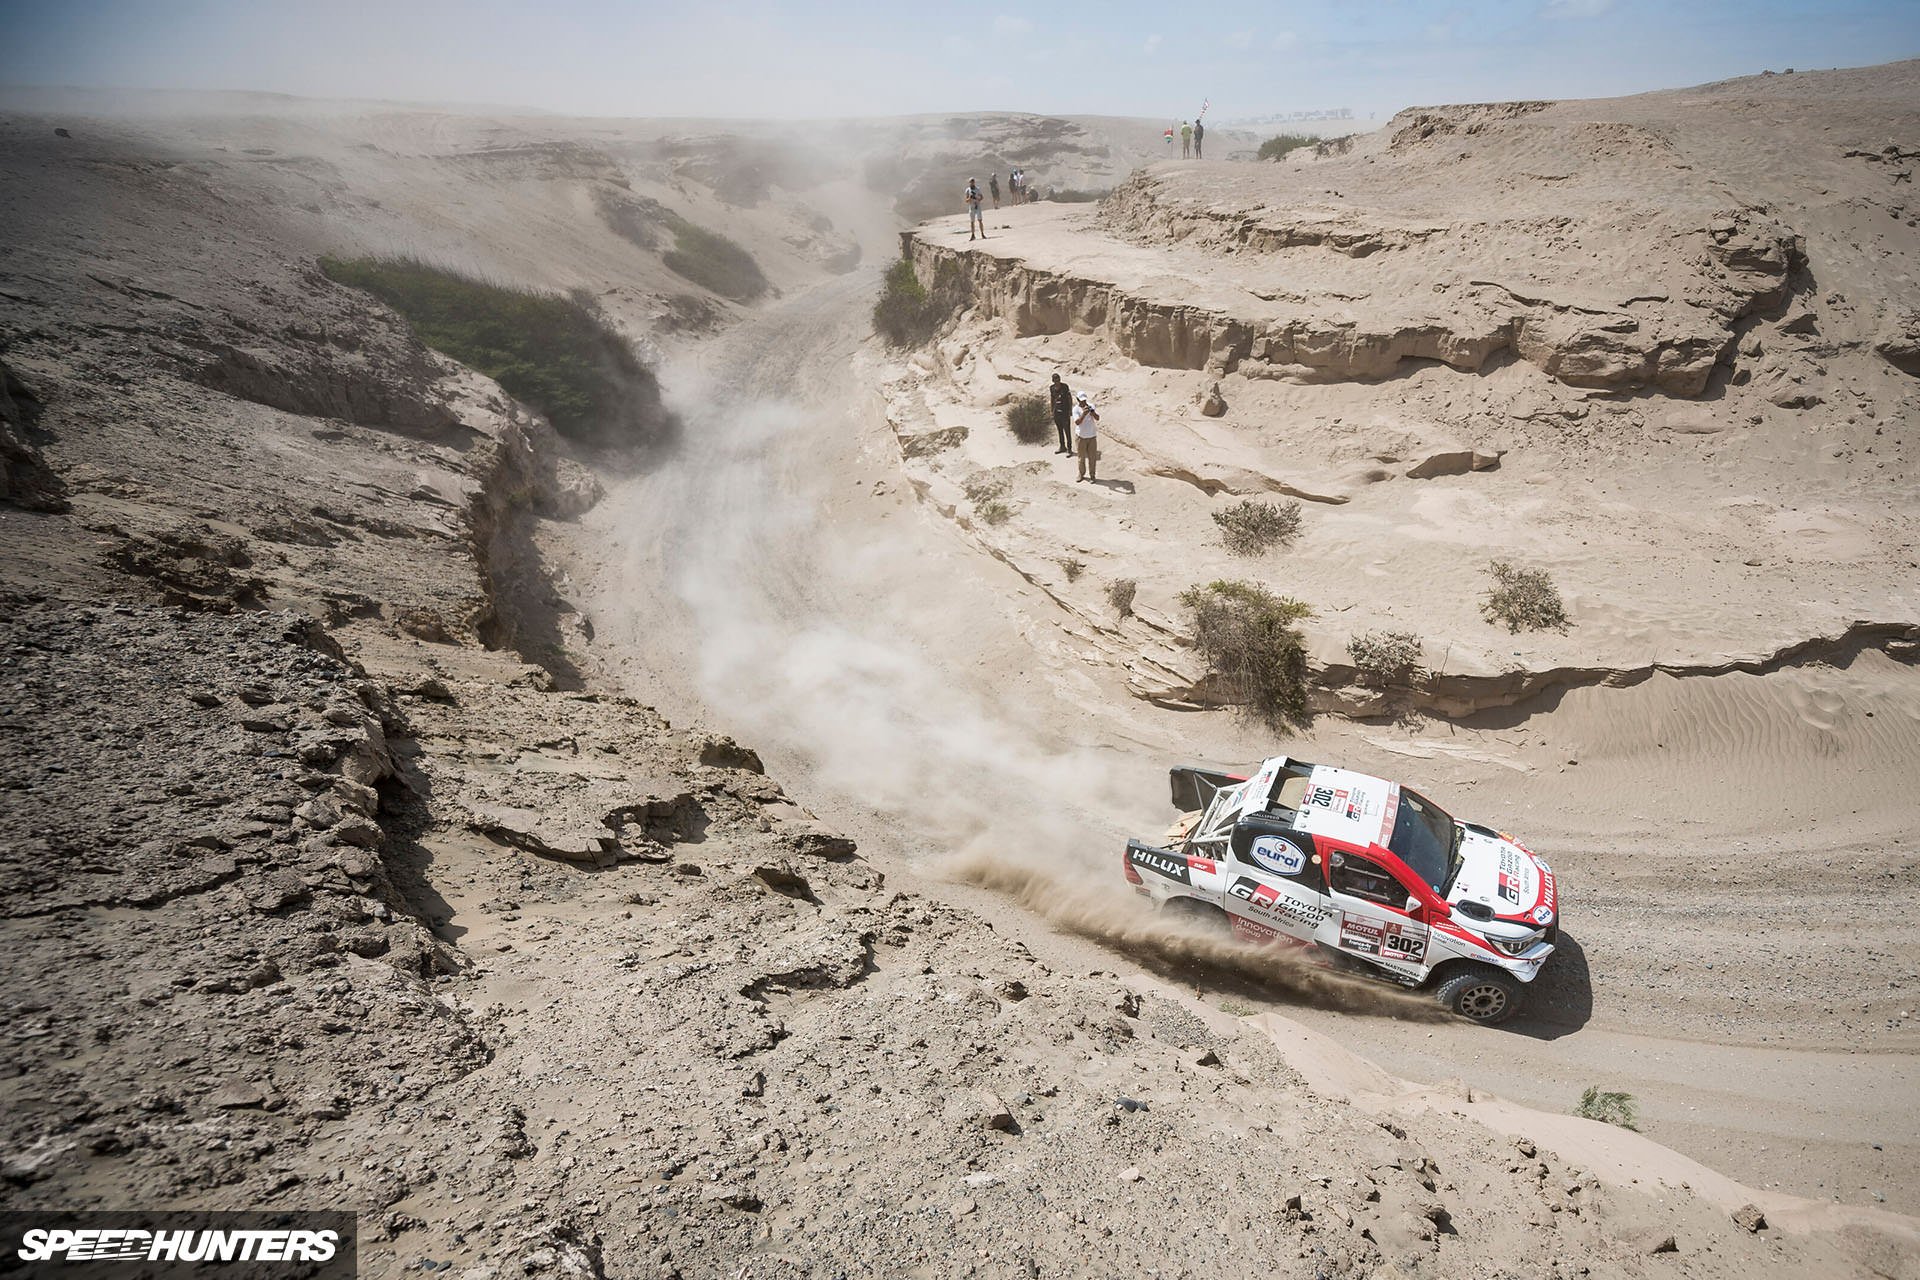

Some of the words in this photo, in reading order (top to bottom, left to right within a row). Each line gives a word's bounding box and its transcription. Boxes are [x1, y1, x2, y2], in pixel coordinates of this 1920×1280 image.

[1311, 787, 1334, 808] 302
[1132, 849, 1186, 877] HILUX
[1256, 846, 1299, 868] eurol
[1229, 883, 1274, 908] GR
[1505, 878, 1520, 905] GR
[1543, 872, 1553, 907] HILUX
[1248, 906, 1271, 918] South
[1272, 915, 1295, 928] Africa
[1278, 903, 1325, 922] GAZOO
[1284, 895, 1333, 918] TOYOTA
[1274, 908, 1320, 929] Racing
[1346, 923, 1379, 935] MOTUL
[1387, 935, 1424, 956] 302
